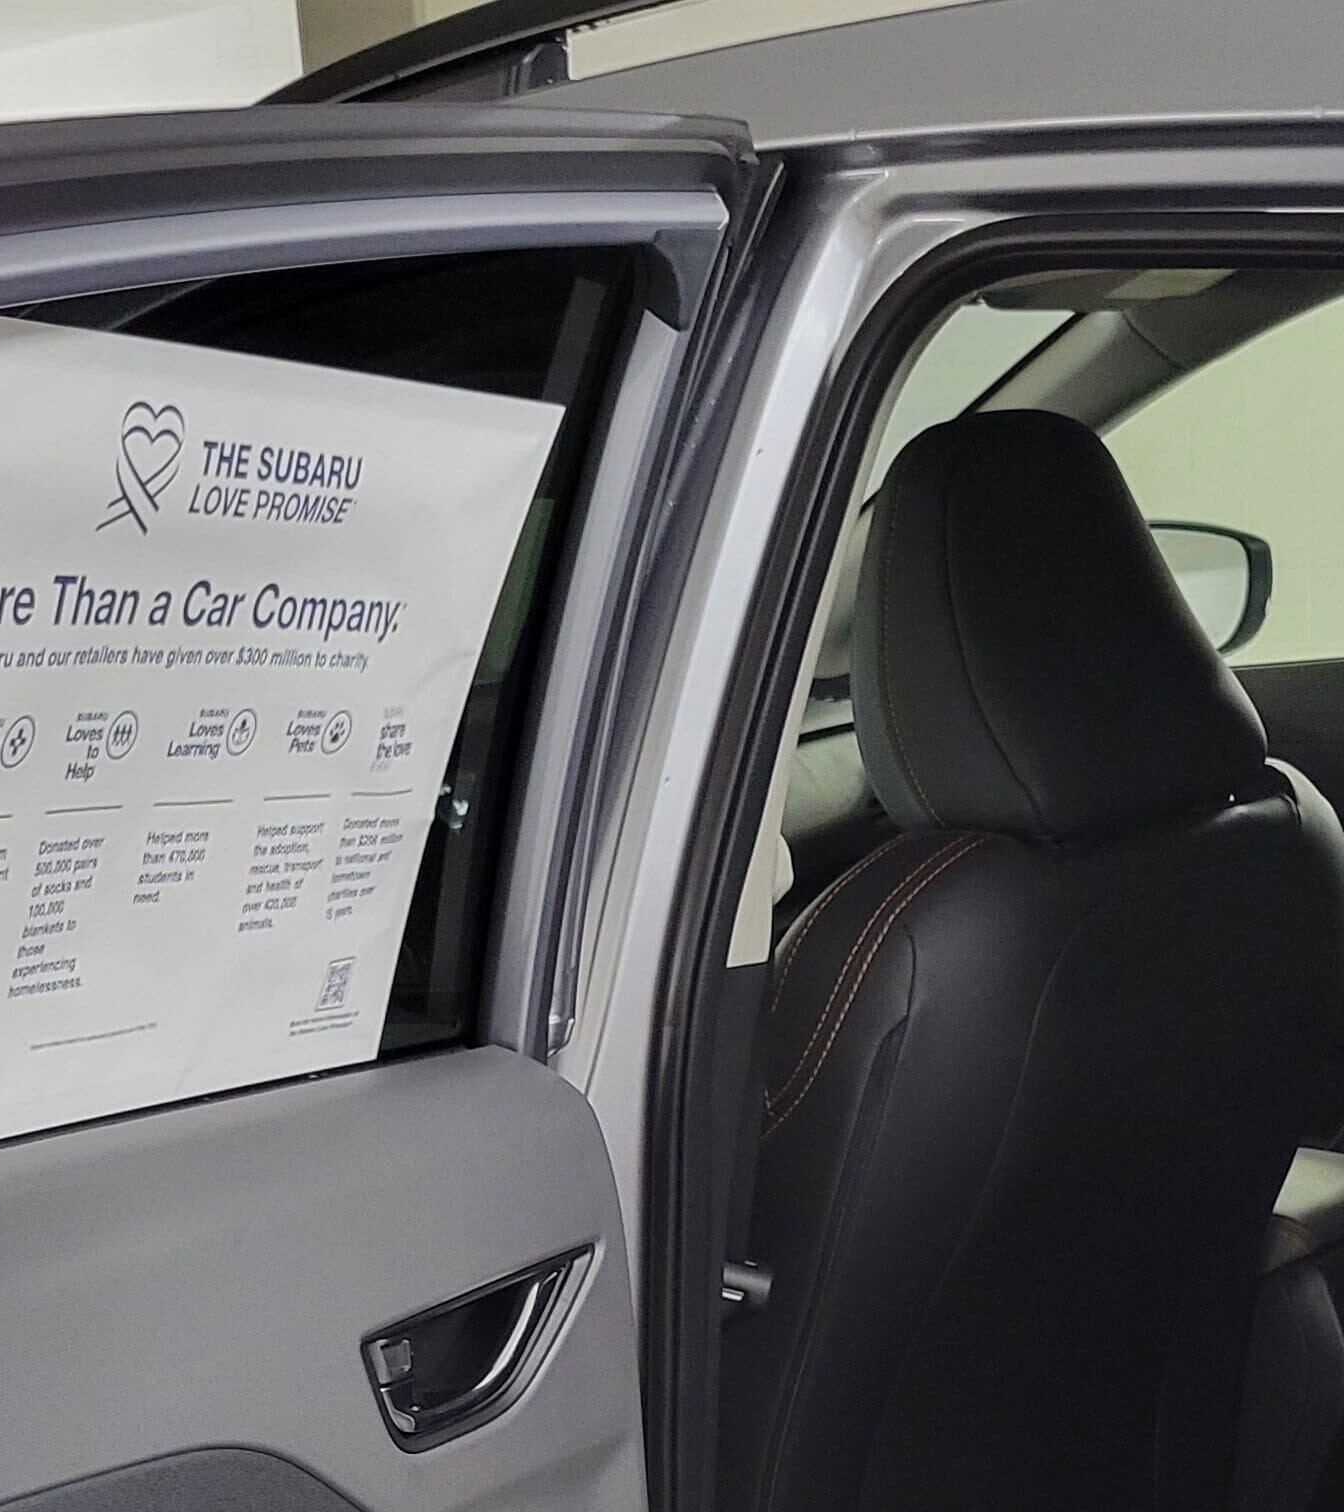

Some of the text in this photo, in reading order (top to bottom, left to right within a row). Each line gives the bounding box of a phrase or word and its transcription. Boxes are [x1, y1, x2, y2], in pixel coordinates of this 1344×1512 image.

[203, 441, 362, 489] THE SUBARU
[189, 484, 351, 524] LOVE PROMISE
[53, 575, 137, 626] Than
[149, 591, 172, 626] a
[183, 581, 246, 627] Car
[18, 649, 43, 667] and
[48, 652, 70, 666] our
[74, 648, 128, 665] retailers
[132, 648, 164, 664] have
[167, 649, 202, 669] given
[205, 652, 234, 664] over
[236, 648, 268, 666] $300
[270, 649, 311, 668] million
[314, 652, 326, 668] to
[66, 725, 104, 742] Loves
[189, 723, 224, 737] Loves
[286, 722, 321, 736] Loves
[87, 745, 99, 759] to
[167, 741, 220, 760] Learning
[288, 738, 315, 753] Pets
[65, 763, 95, 782] Help
[39, 837, 105, 855] Donated over
[147, 832, 182, 847] Helped
[73, 858, 97, 875] pairs
[32, 876, 92, 898] of socks and
[22, 920, 76, 939] blankets to
[12, 959, 76, 979] experiencing
